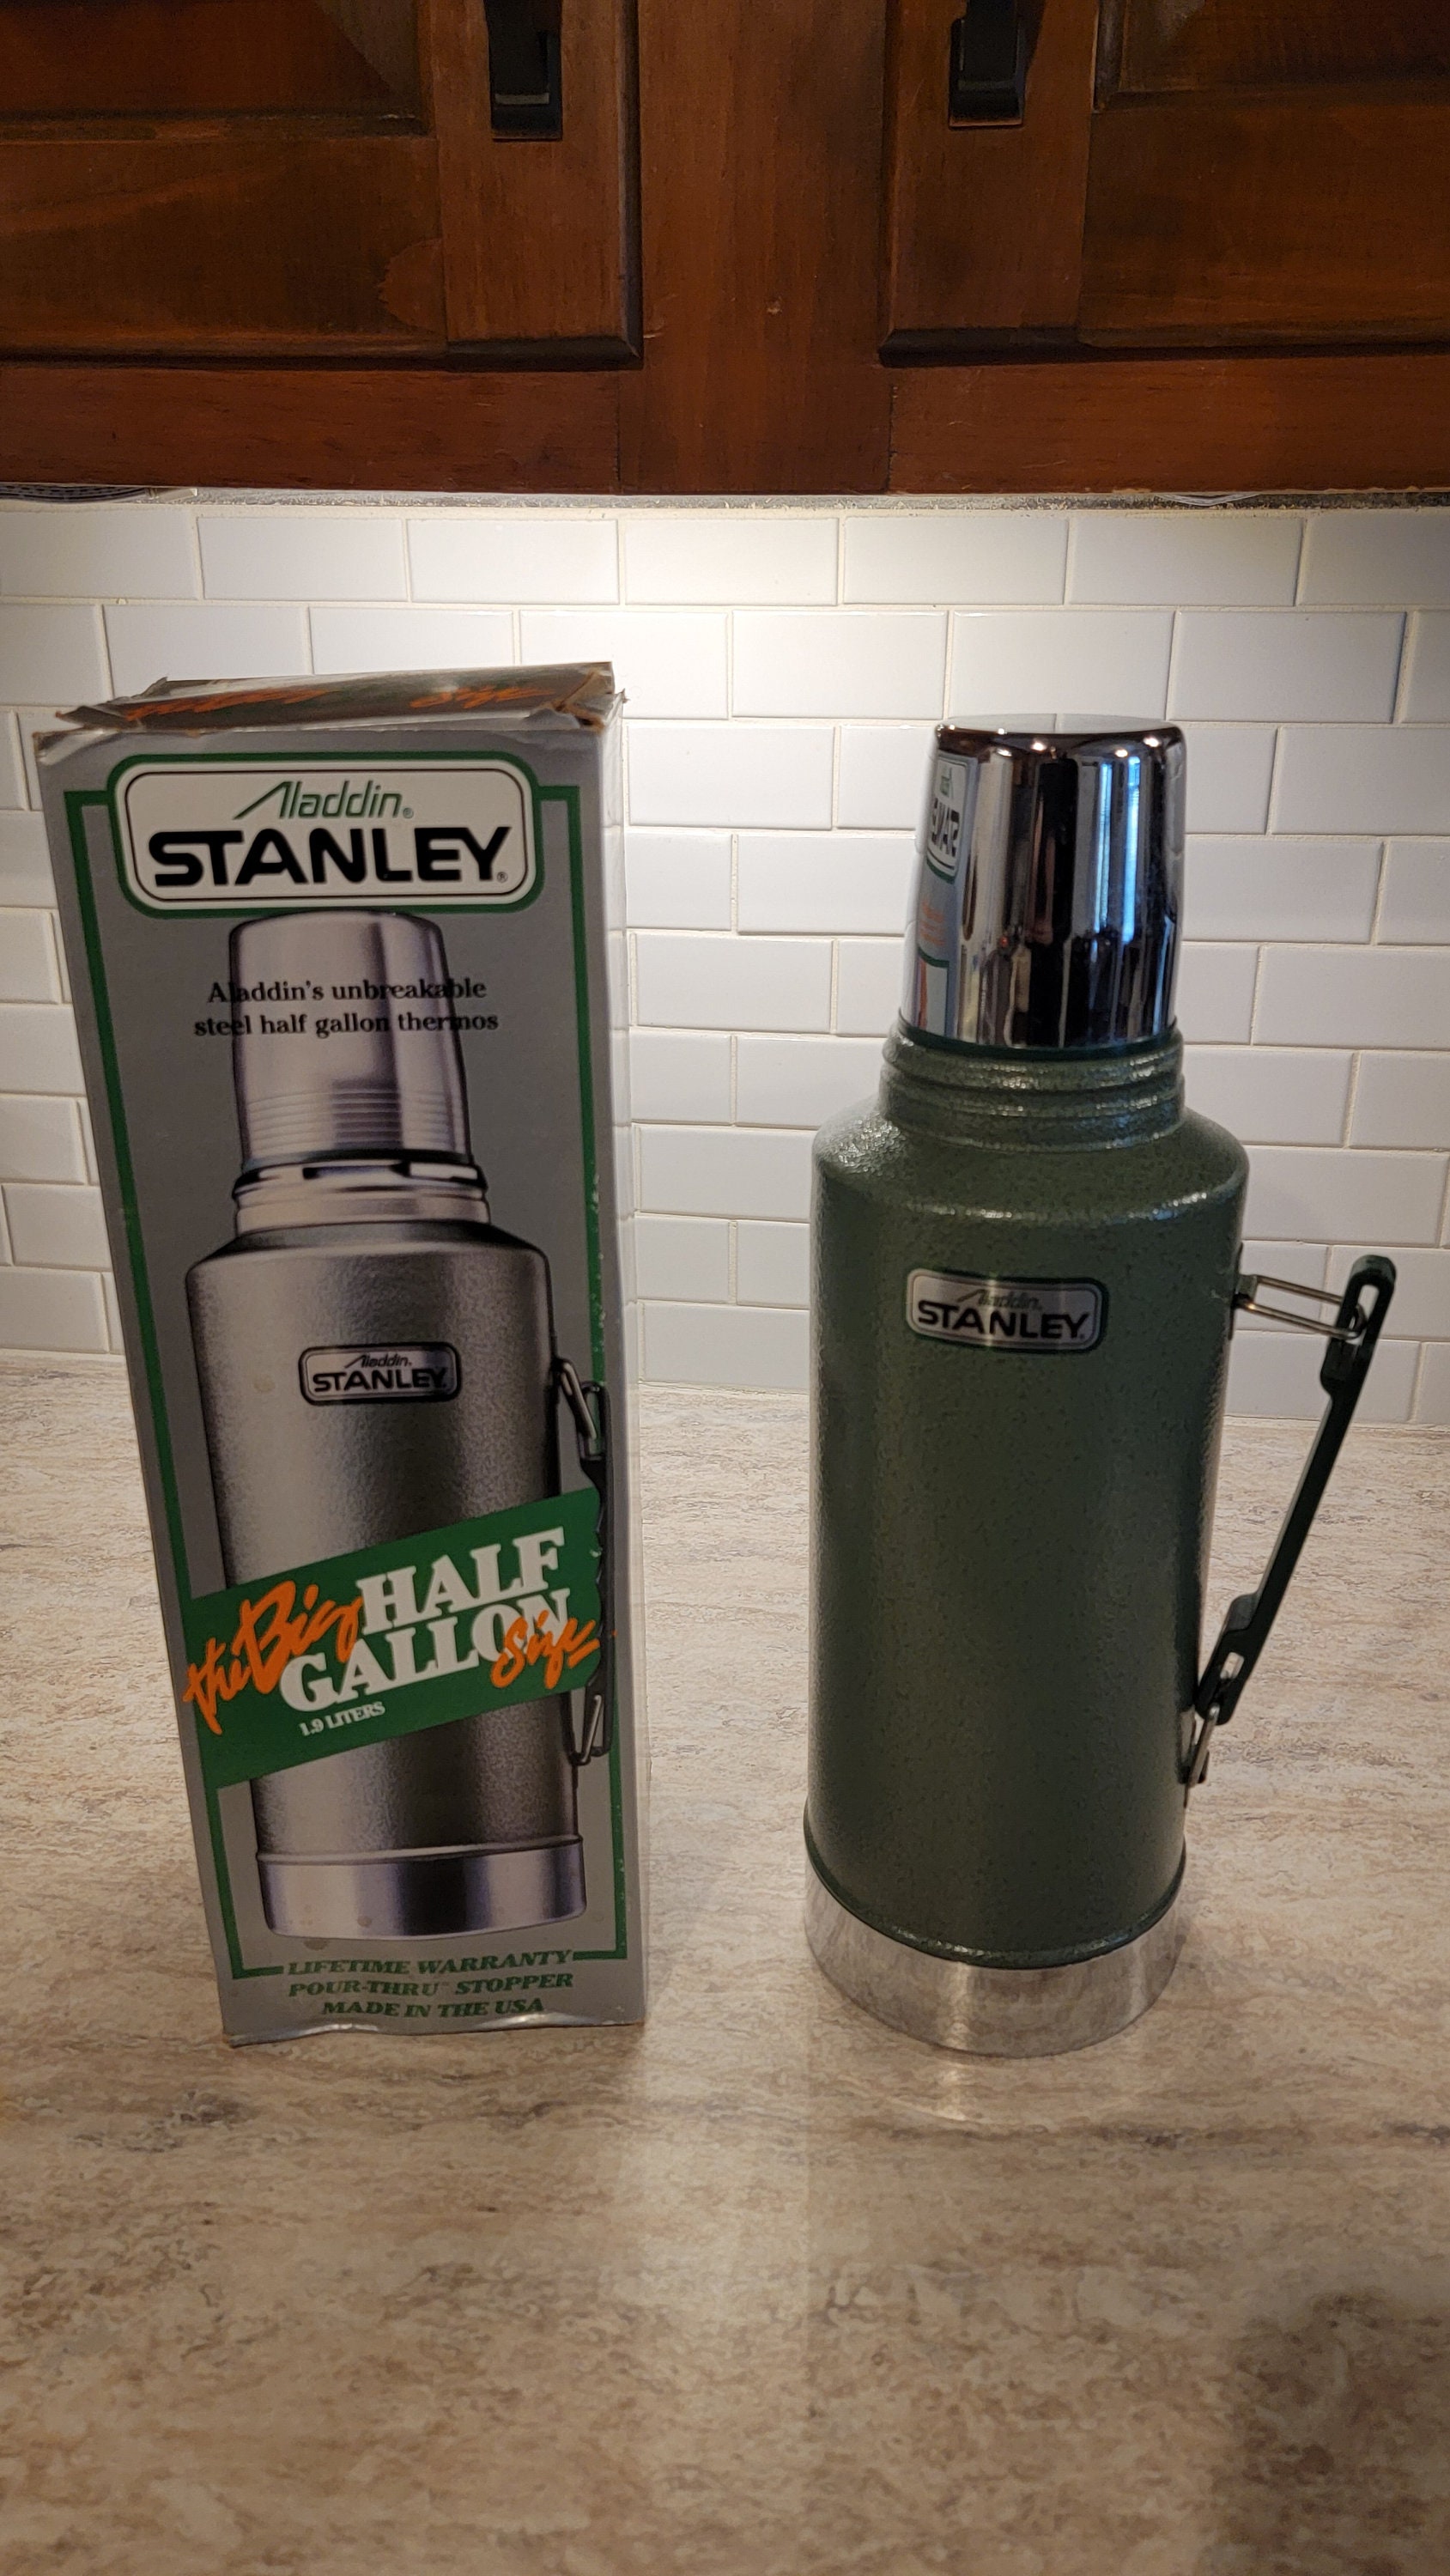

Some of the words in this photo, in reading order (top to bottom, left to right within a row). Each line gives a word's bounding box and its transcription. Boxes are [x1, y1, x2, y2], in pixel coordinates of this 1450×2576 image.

[234, 780, 403, 820] Aladdin
[149, 826, 512, 887] STANLEY
[207, 981, 325, 1003] Aladdin's
[332, 978, 488, 999] unbreakable
[194, 1015, 252, 1036] steel
[260, 1014, 308, 1034] half
[315, 1012, 387, 1039] gallon
[397, 1012, 500, 1031] thermos
[918, 1299, 1090, 1339] STANLEY
[312, 1368, 447, 1392] STANLEY
[356, 1526, 566, 1635] HALF
[232, 1580, 364, 1695] Big
[279, 1589, 571, 1712] GALLON
[299, 1718, 325, 1736] 1.9
[325, 1701, 386, 1728] LITERS
[288, 1959, 411, 1975] LIFETIME
[417, 1949, 573, 1974] WARRANTY
[288, 1980, 440, 1997] POUR-THRU
[455, 1973, 574, 1995] STOPPER
[322, 2002, 401, 2016] MADE
[404, 2004, 432, 2018] IN
[437, 2002, 490, 2017] THE
[495, 1997, 545, 2014] USA
